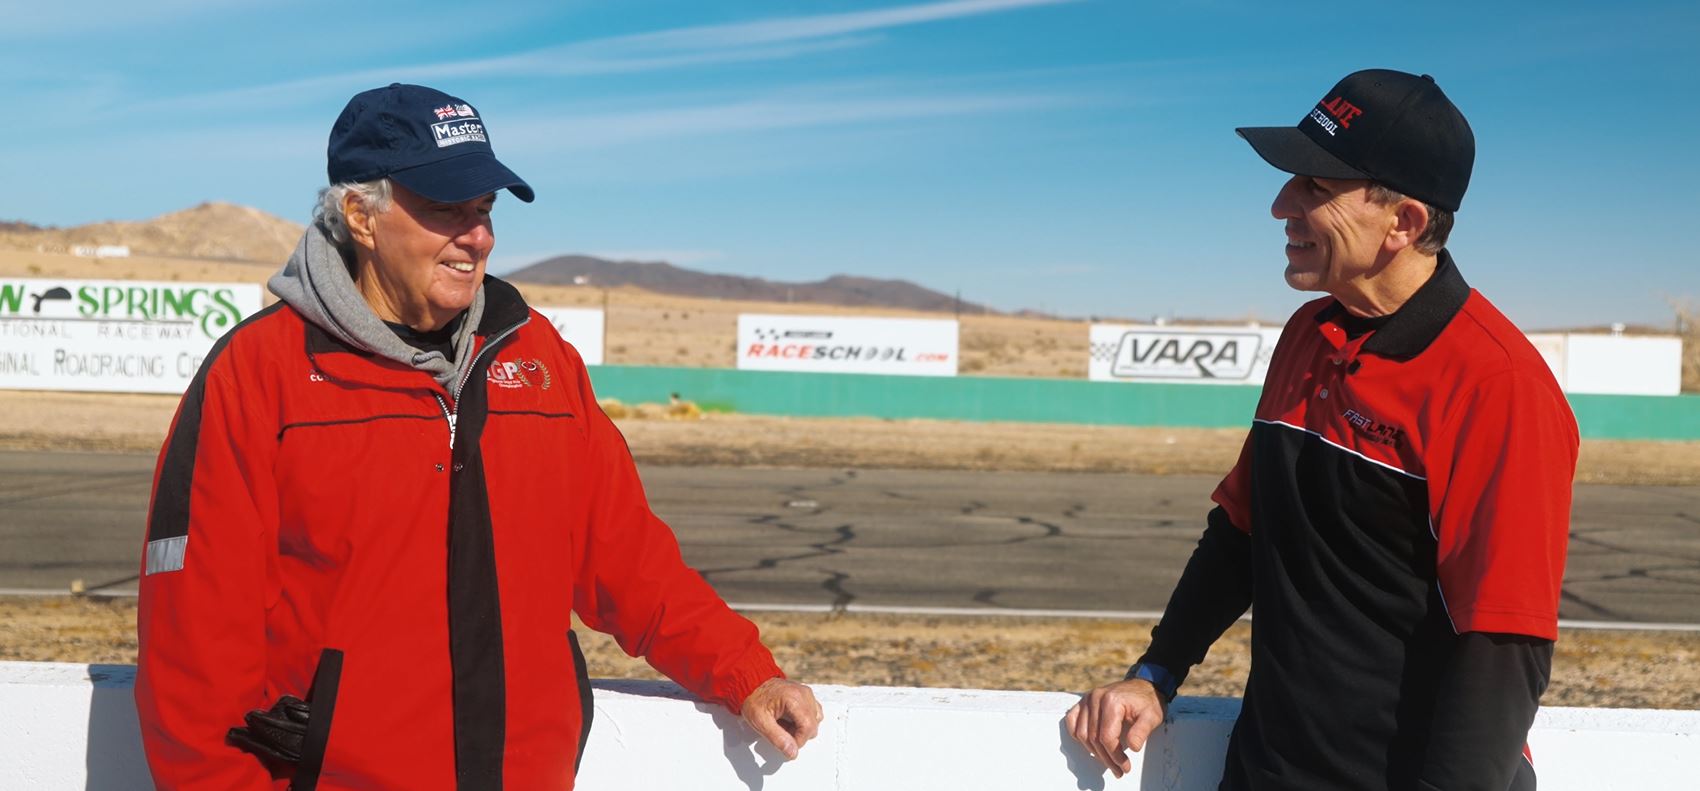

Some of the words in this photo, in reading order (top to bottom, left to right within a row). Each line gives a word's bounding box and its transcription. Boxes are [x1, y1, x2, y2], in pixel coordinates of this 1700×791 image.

[78, 286, 242, 340] SPRINGS
[97, 327, 193, 340] RACEWAY
[487, 360, 518, 380] GP
[1132, 339, 1238, 378] VARA
